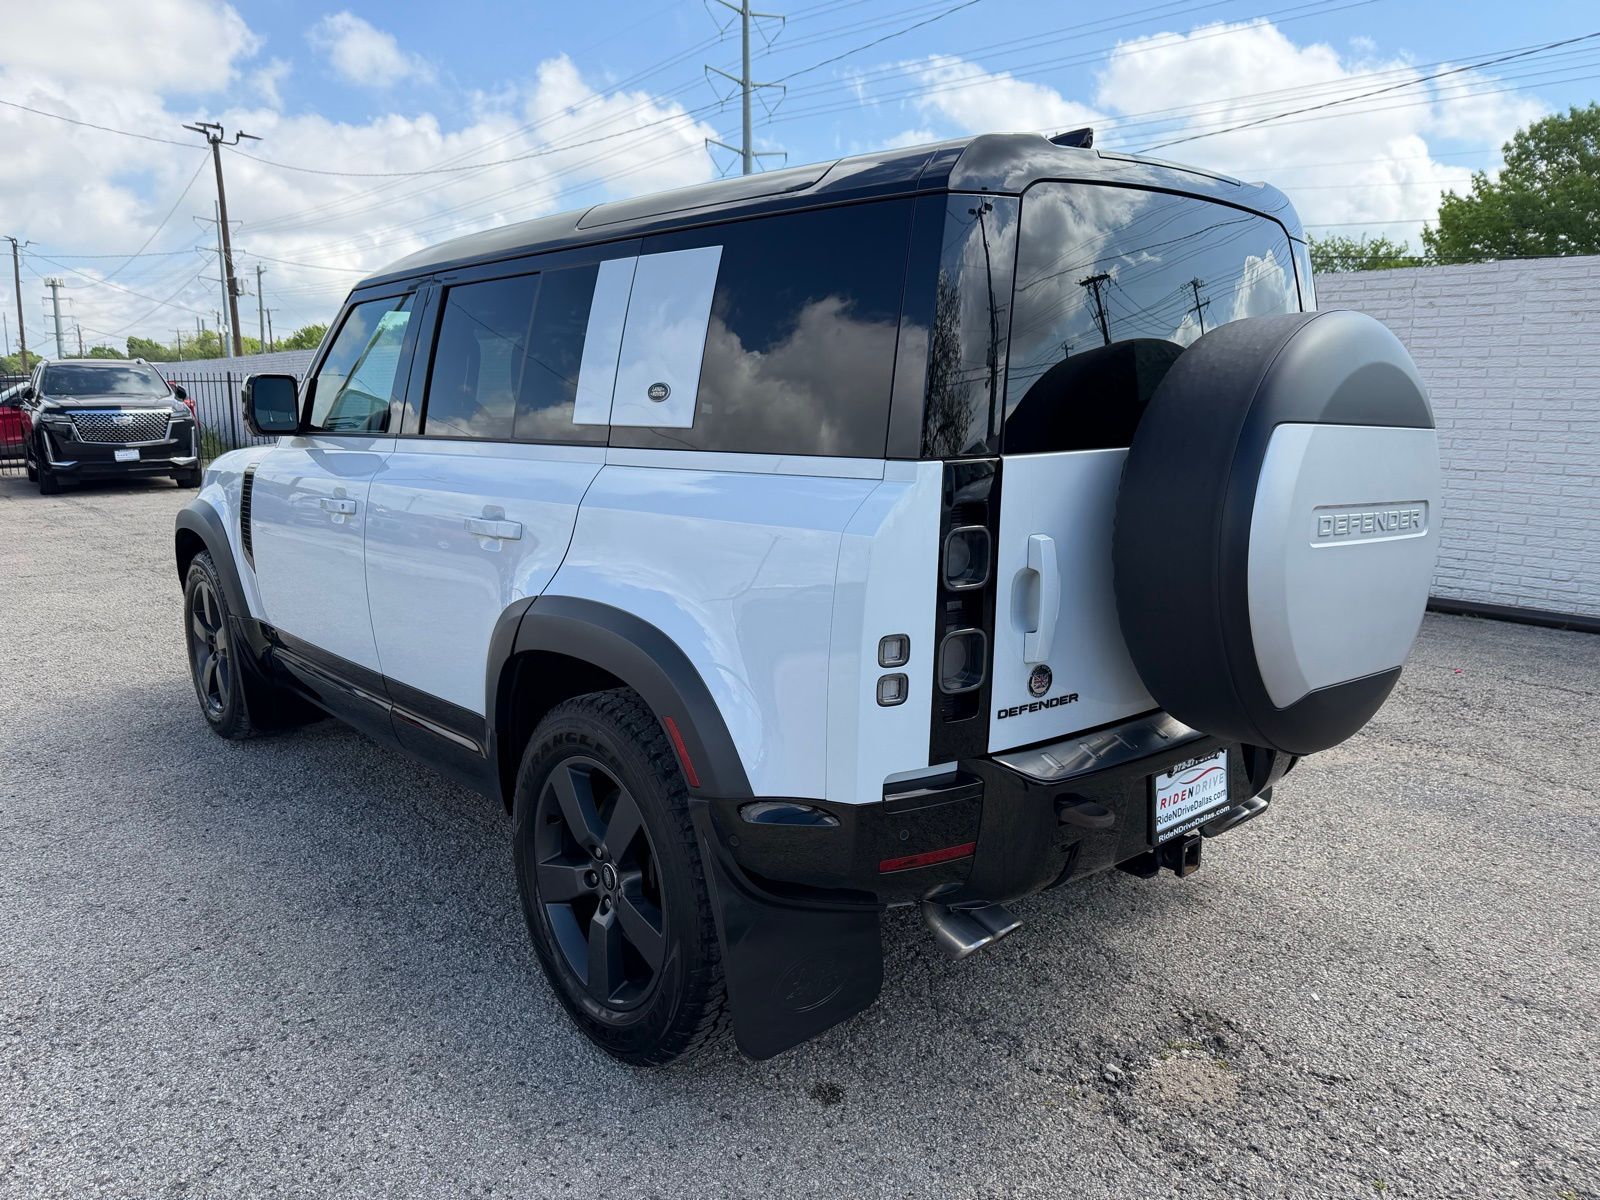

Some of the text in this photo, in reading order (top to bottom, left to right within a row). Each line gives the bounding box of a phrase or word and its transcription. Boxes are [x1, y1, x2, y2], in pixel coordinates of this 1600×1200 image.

[1317, 509, 1420, 537] DEFENDER
[997, 693, 1079, 720] DEFENDER
[1157, 788, 1227, 825] RideNDriveDallas.com
[1158, 805, 1231, 842] RideNDriveDallas.com
